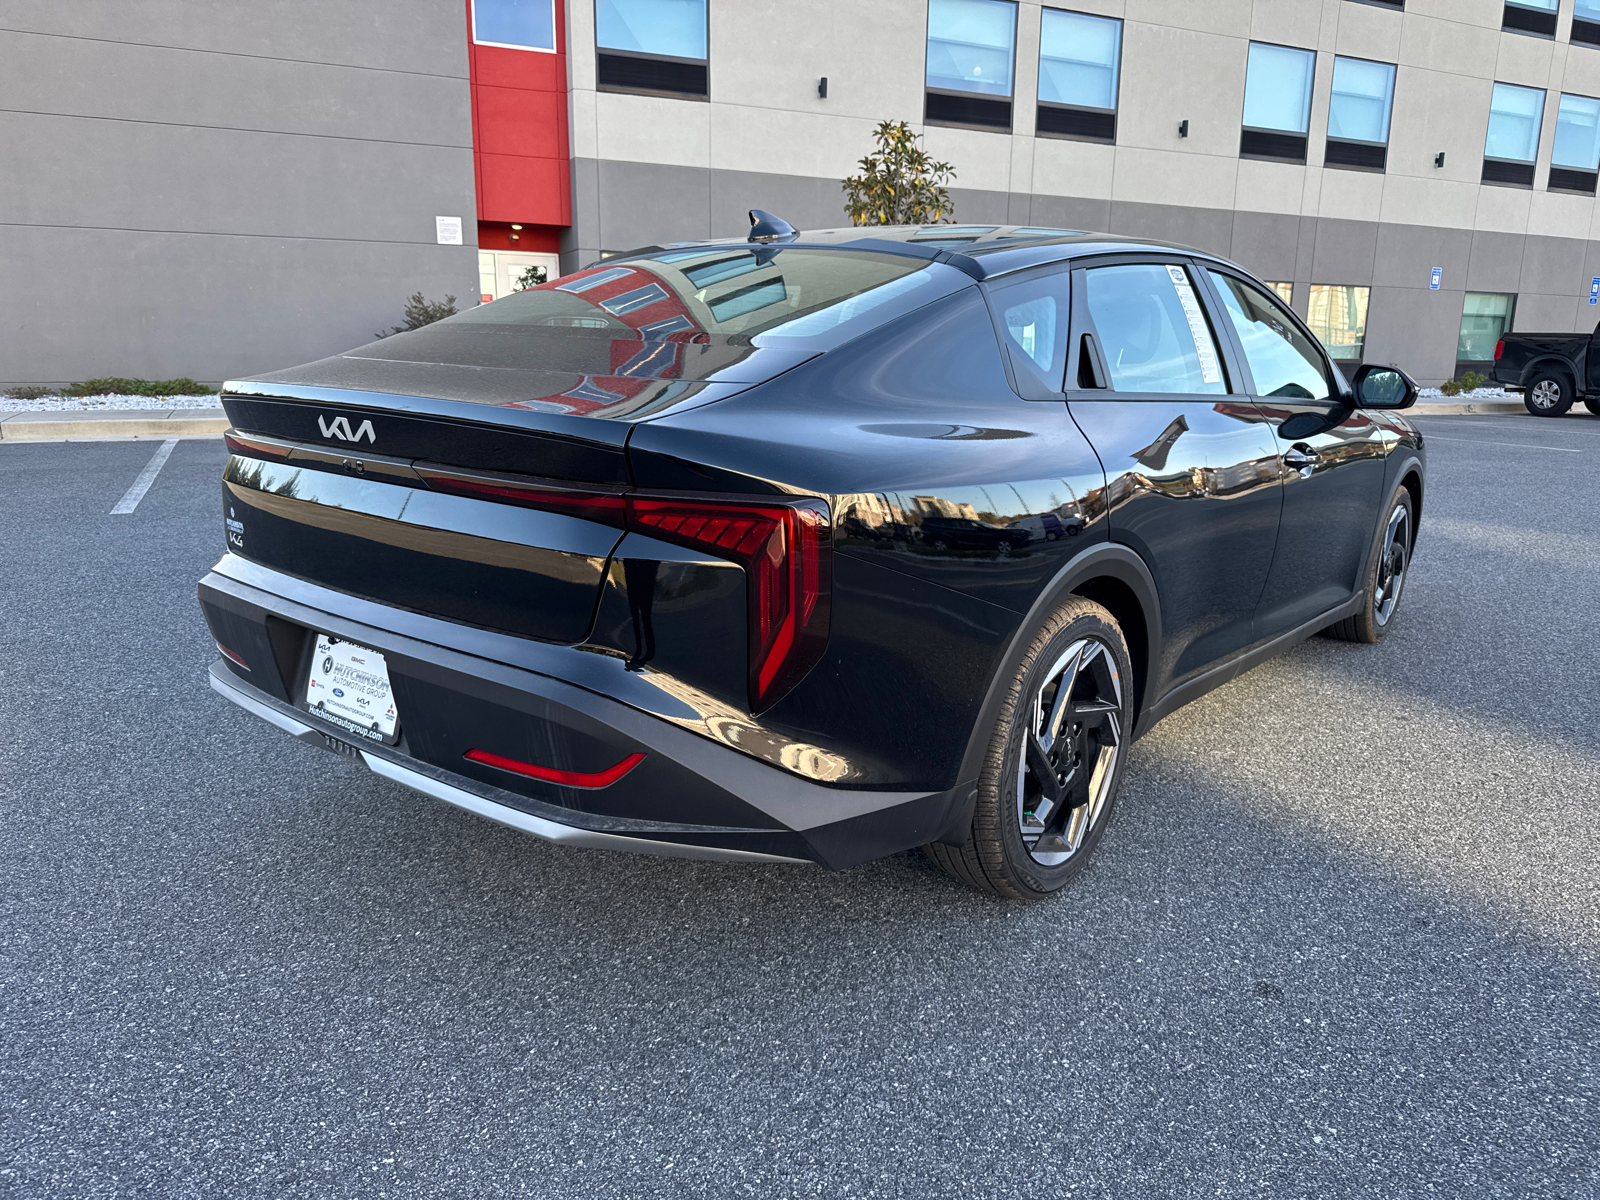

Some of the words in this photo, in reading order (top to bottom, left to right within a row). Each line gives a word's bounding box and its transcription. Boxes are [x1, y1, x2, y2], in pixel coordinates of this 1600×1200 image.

[317, 414, 377, 445] KIA
[229, 531, 244, 548] K4
[350, 656, 366, 665] GMC
[332, 676, 366, 694] AUTOMOTIVE
[366, 687, 387, 700] GROUP
[333, 662, 390, 692] HUTCHINSON
[356, 697, 370, 706] KIA
[308, 704, 383, 742] Hutchinsonautogroup.com
